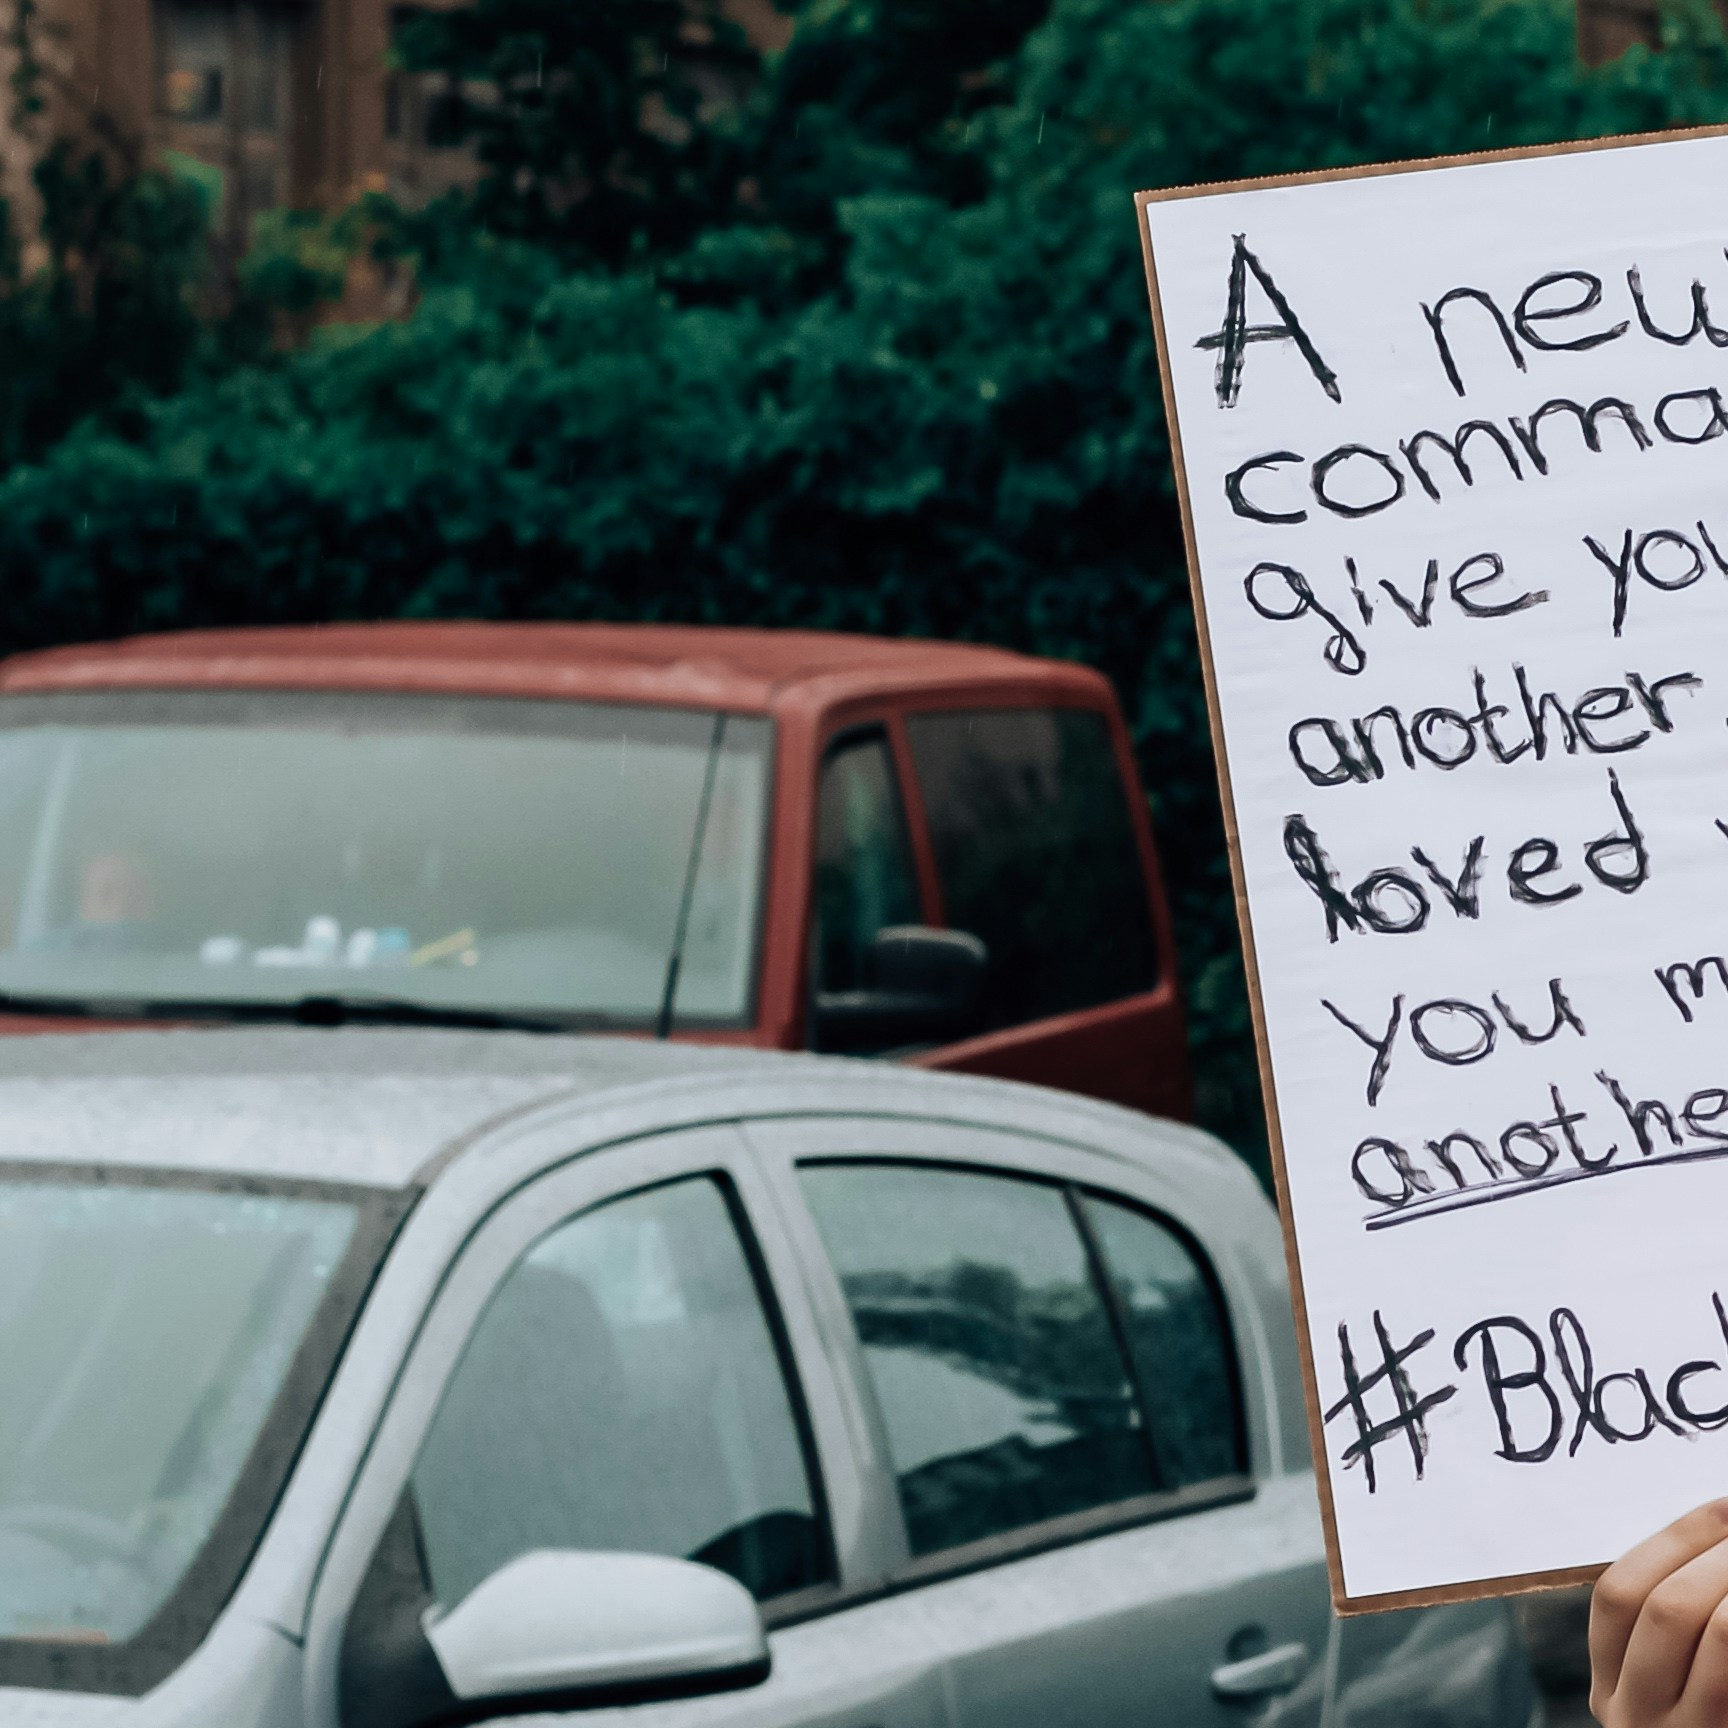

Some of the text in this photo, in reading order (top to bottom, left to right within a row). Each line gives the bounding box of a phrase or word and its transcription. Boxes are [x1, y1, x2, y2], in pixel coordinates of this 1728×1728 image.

[1192, 232, 1342, 410] A
[1243, 552, 1550, 676] give
[1283, 766, 1650, 945] loved
[1320, 977, 1586, 1108] you
